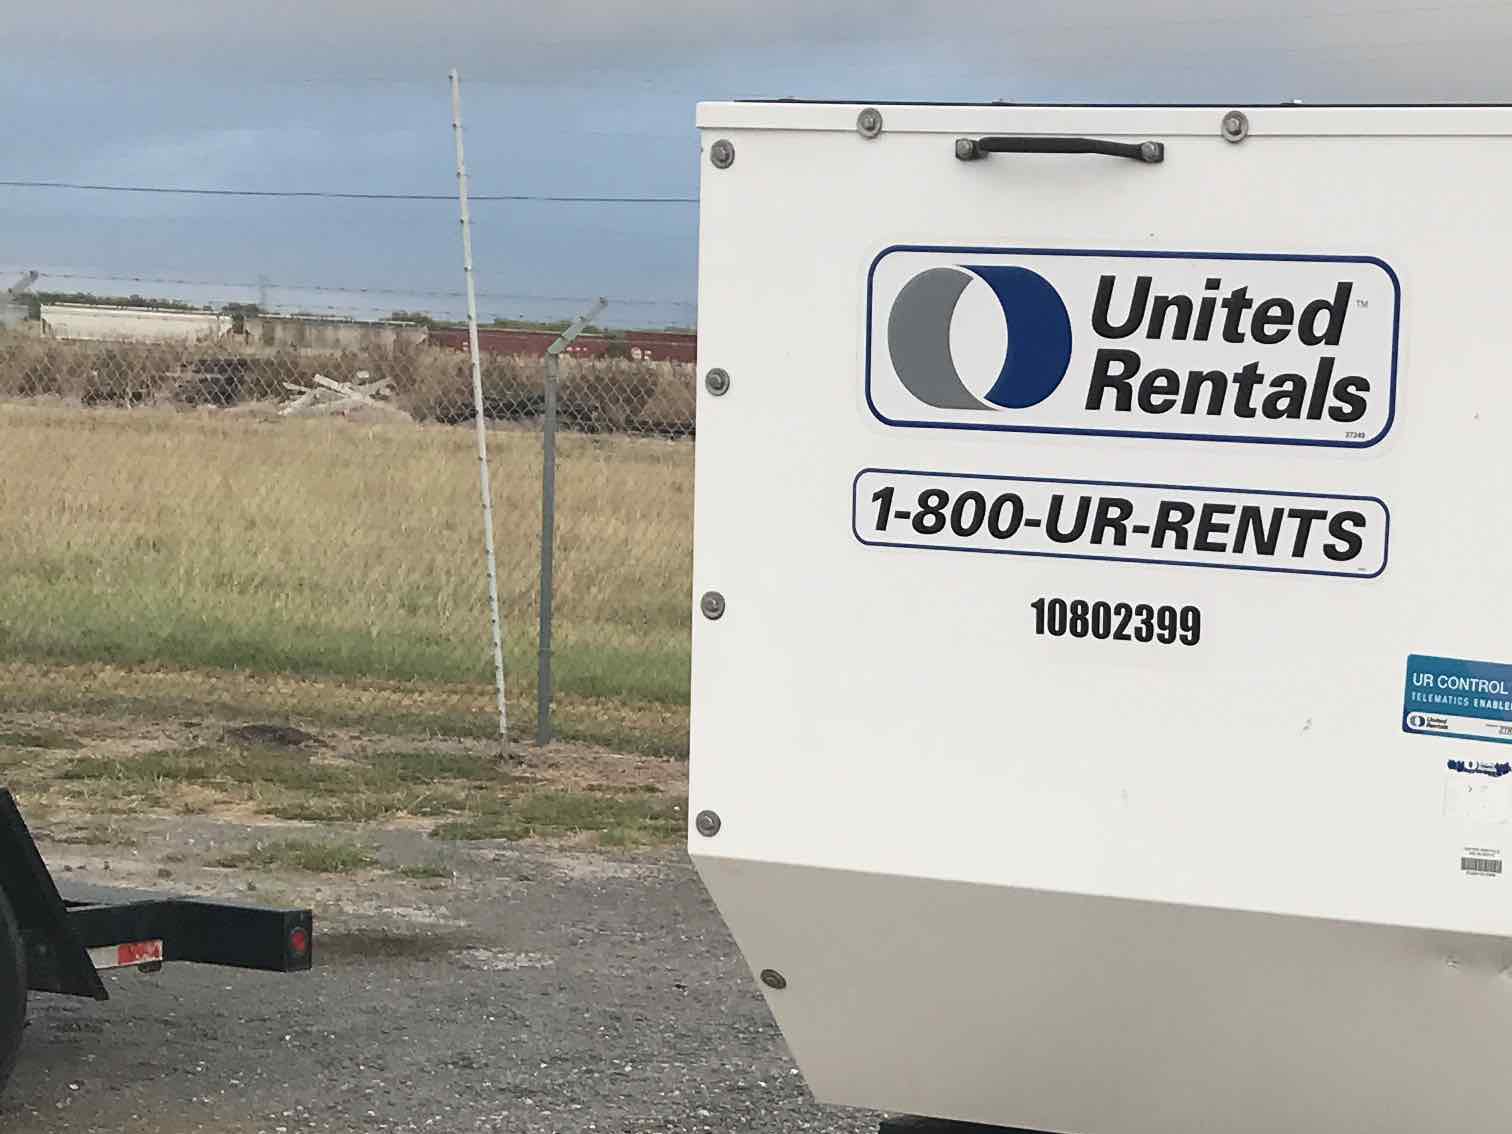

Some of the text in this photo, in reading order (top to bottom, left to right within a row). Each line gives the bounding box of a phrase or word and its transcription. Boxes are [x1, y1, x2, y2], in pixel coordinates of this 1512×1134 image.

[1091, 275, 1354, 346] United
[1085, 349, 1370, 422] Rentals
[871, 486, 1367, 561] 1-800-UR-RENTS
[1031, 598, 1201, 646] 10802399
[1411, 691, 1470, 707] TELEMATICS
[1412, 672, 1509, 695] UR CONTROL
